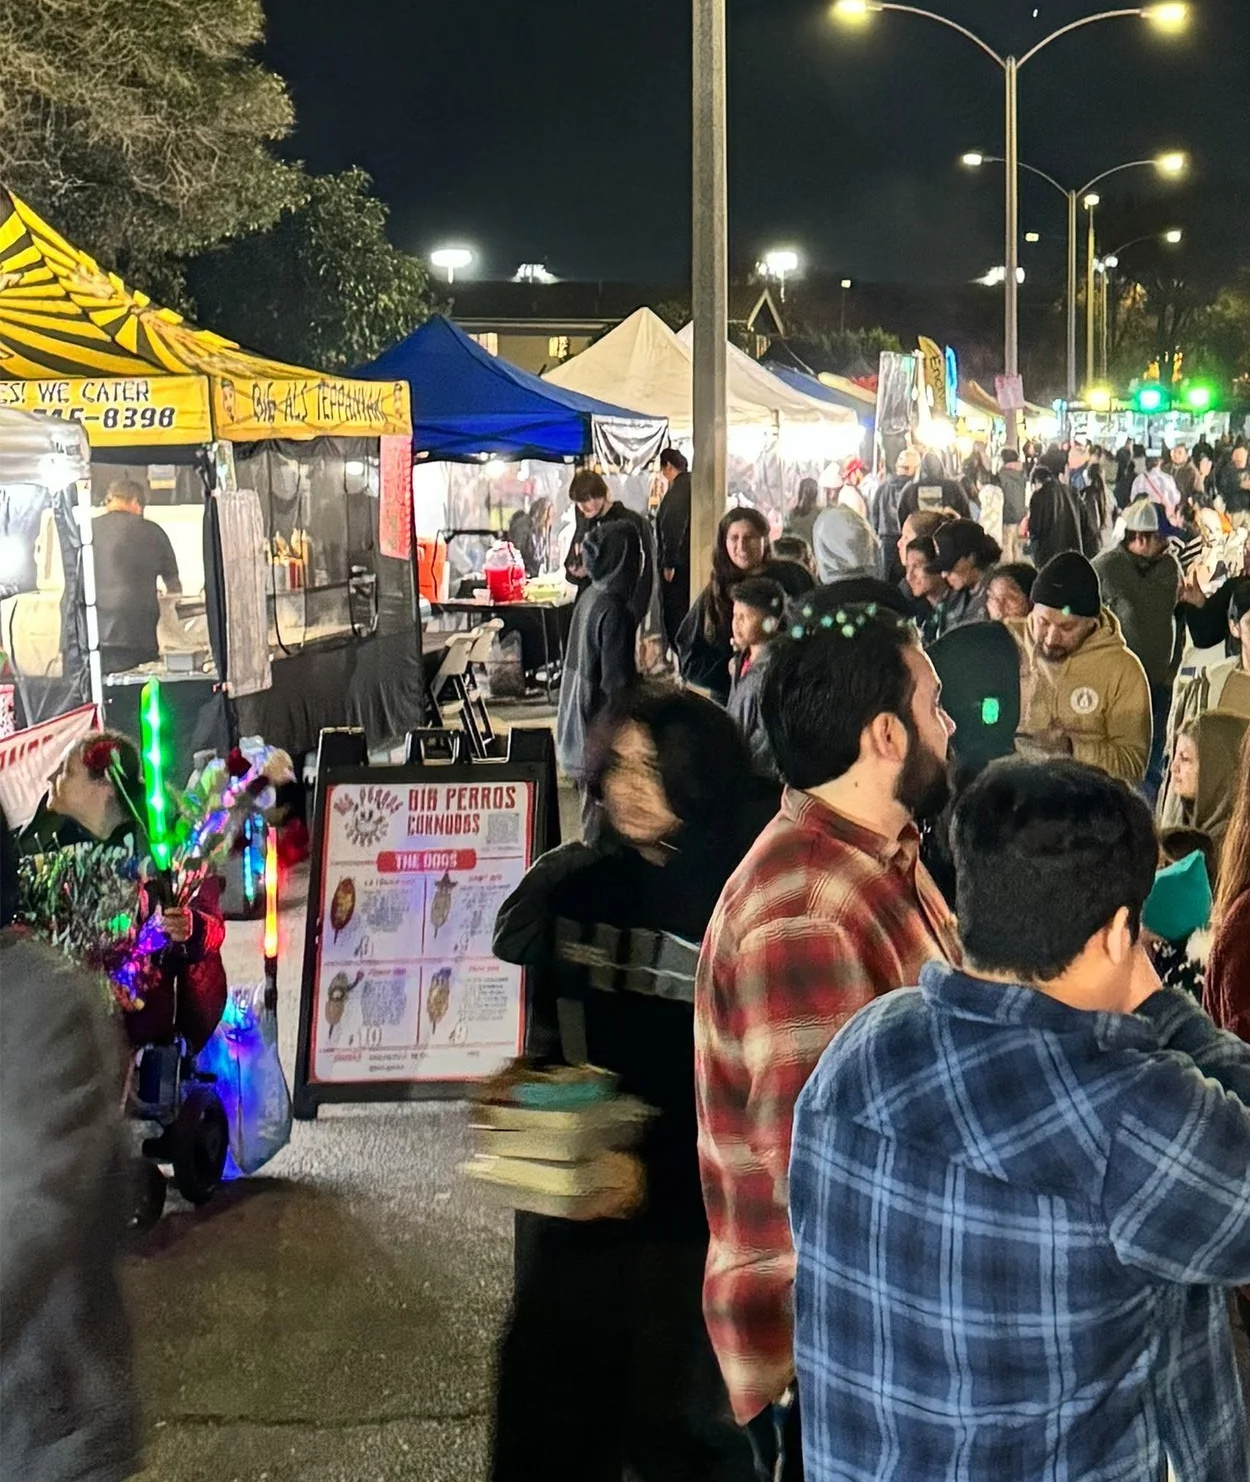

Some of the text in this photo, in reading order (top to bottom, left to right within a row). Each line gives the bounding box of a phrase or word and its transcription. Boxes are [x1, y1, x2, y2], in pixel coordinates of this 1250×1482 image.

[38, 382, 70, 403] WE
[82, 380, 149, 403] CATER
[252, 382, 277, 423] BIG
[33, 407, 175, 429] 5-8398
[446, 786, 516, 810] PERROS
[408, 813, 481, 836] CORNUDOS
